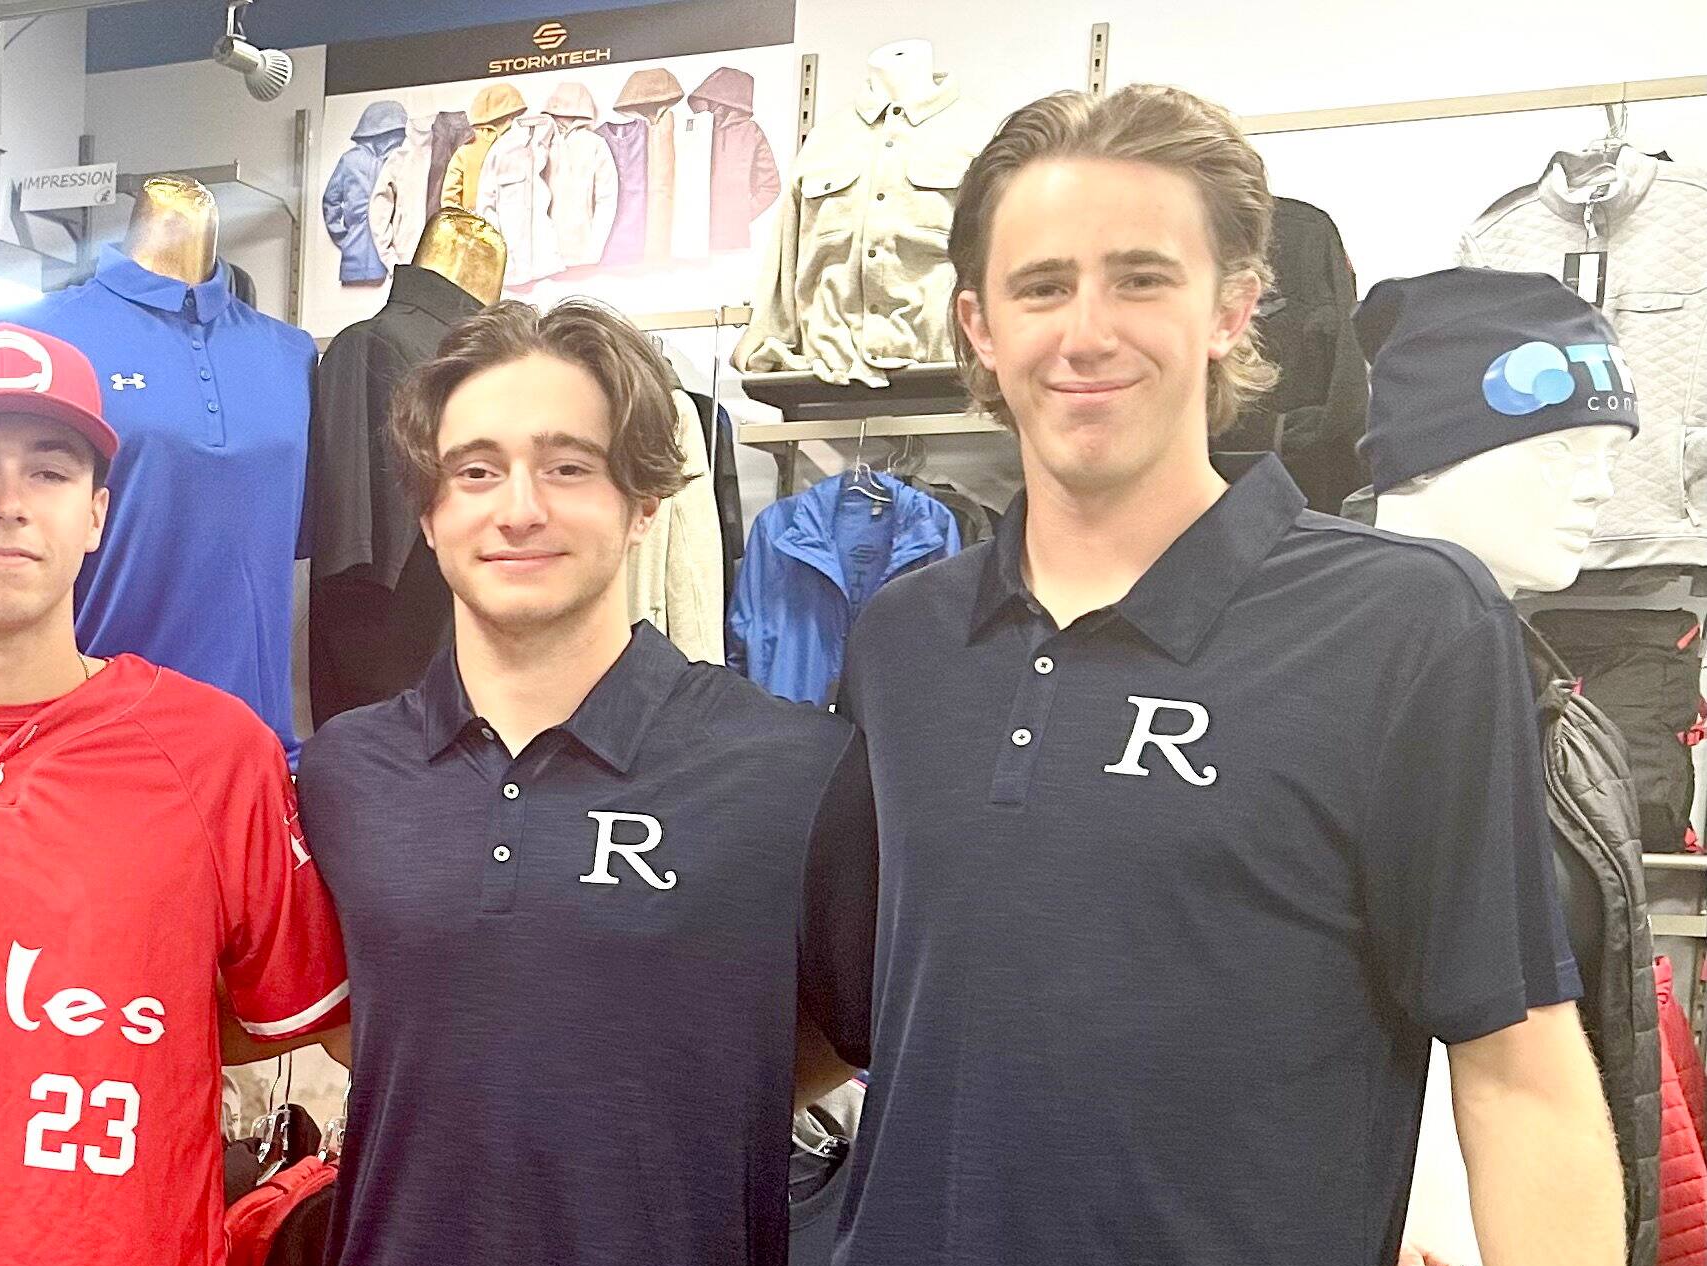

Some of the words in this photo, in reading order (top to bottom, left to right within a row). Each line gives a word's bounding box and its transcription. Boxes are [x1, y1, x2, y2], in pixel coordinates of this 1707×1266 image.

[488, 48, 611, 73] STORMTECH
[23, 171, 113, 190] IMPRESSION
[1104, 695, 1218, 787] R
[579, 810, 678, 890] R
[23, 1072, 142, 1177] 23
